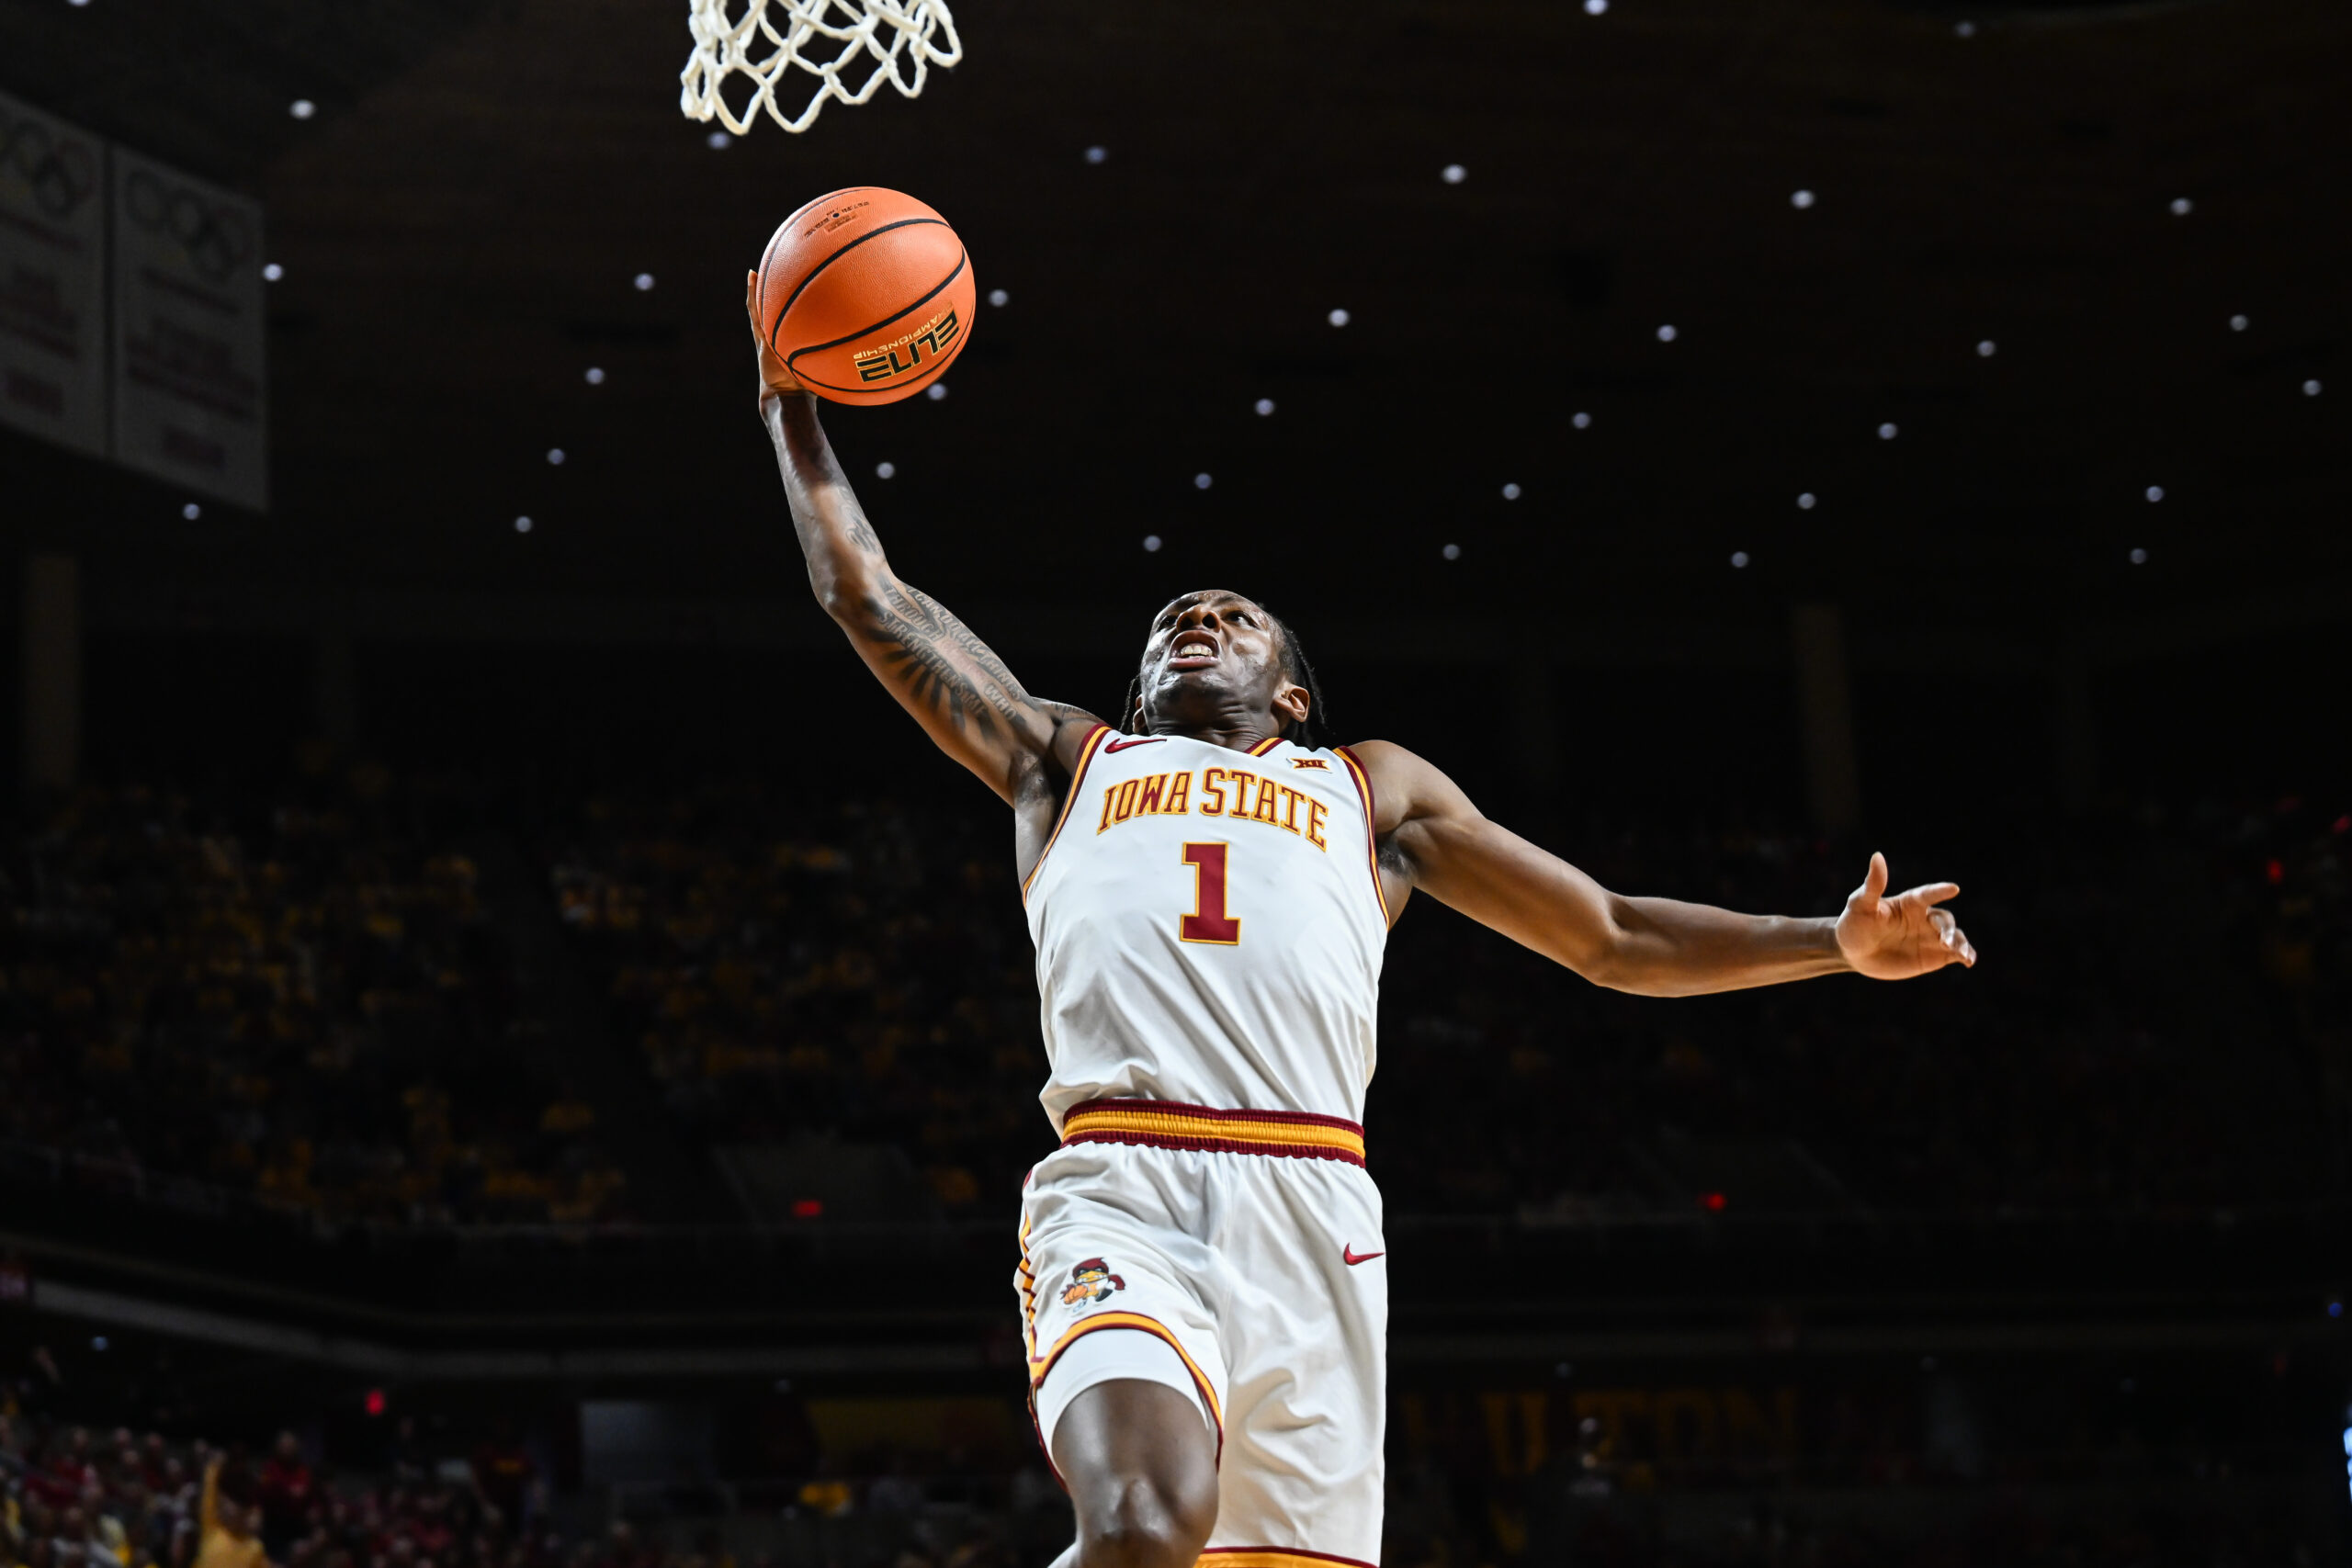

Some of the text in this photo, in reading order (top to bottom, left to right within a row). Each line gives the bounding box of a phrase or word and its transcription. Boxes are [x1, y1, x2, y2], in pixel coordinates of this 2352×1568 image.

[854, 309, 959, 382] ELITE
[879, 610, 969, 699] STRENGTHENS
[885, 586, 1018, 720] THROUGH WHO
[914, 592, 944, 619] CAN
[978, 650, 1022, 702] THINGS
[1096, 766, 1329, 852] IOWA STATE
[1179, 841, 1241, 945] 1
